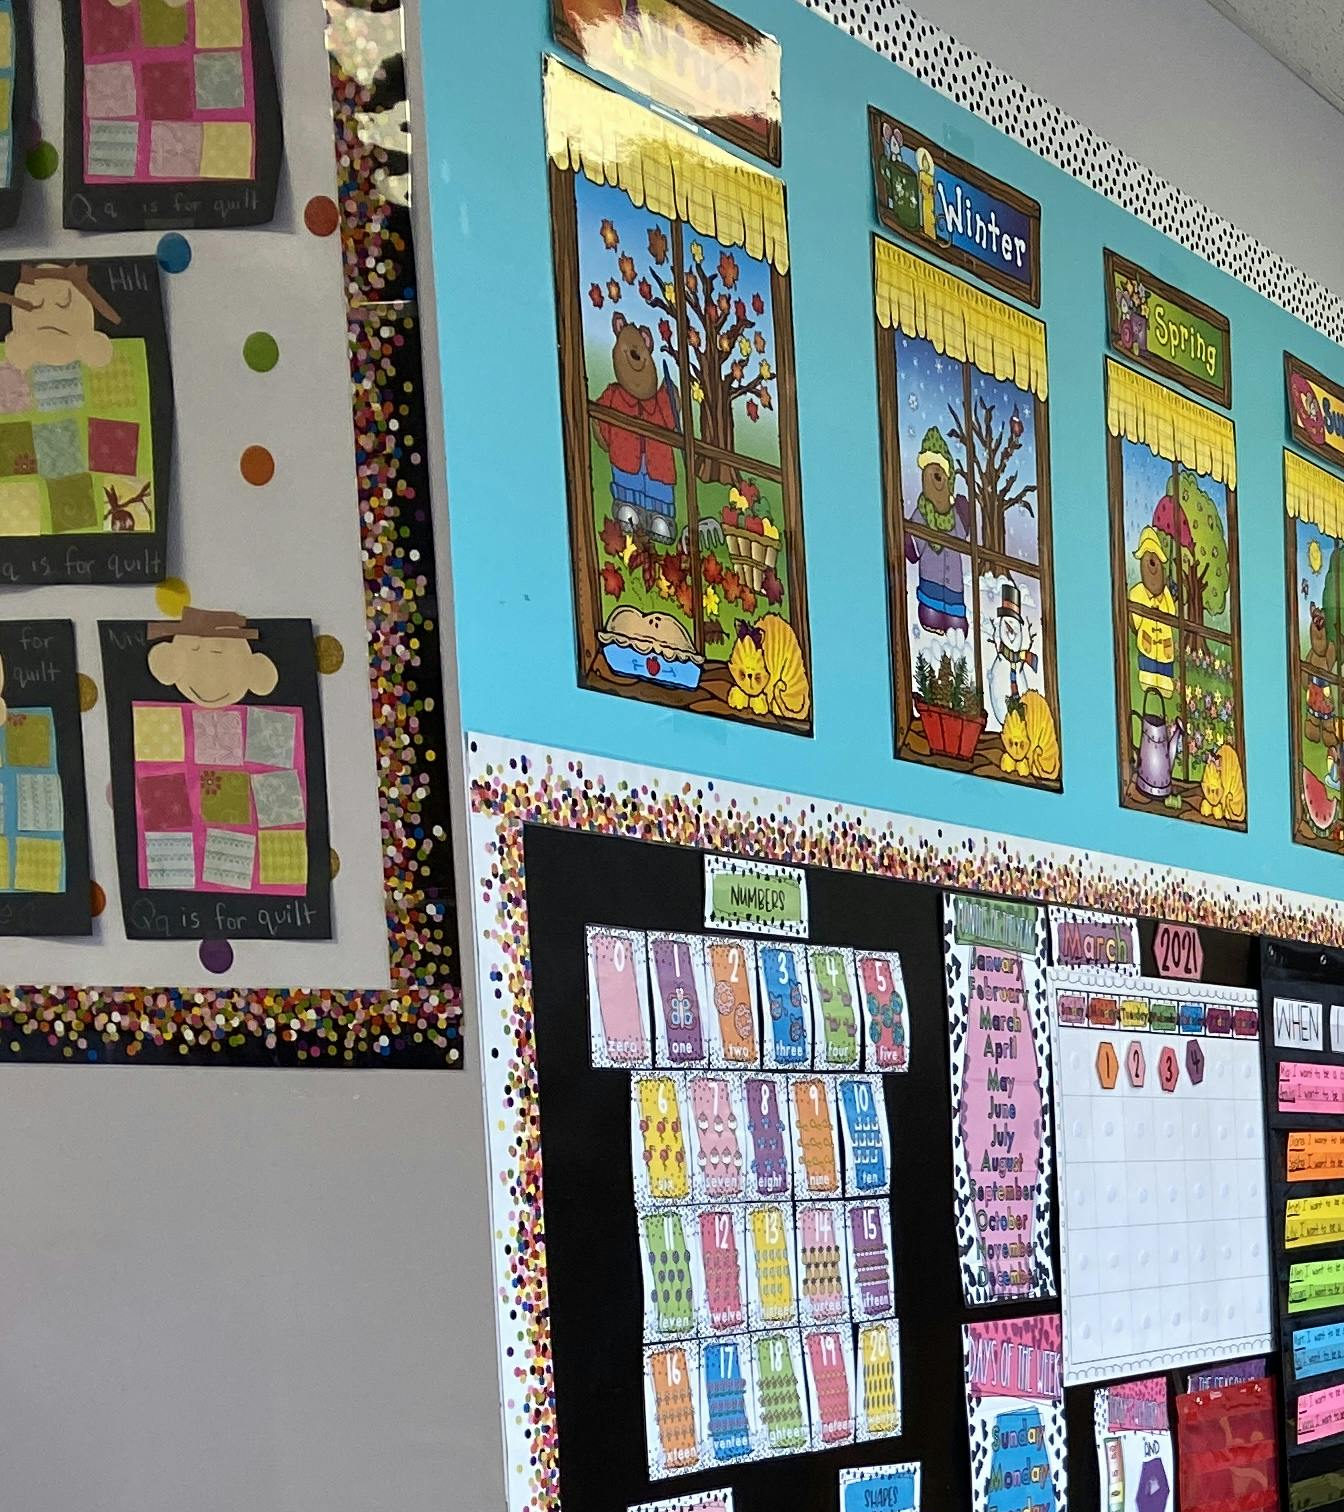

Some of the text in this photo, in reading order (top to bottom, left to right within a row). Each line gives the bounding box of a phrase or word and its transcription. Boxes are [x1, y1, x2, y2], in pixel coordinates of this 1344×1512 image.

[936, 182, 1028, 269] Winter
[1153, 305, 1217, 376] Spring
[731, 885, 785, 912] NUMBERS
[181, 901, 317, 934] is for quilt
[614, 942, 625, 972] 0
[1063, 923, 1129, 962] March
[1161, 928, 1198, 974] 2021
[674, 944, 680, 978] 1
[728, 949, 740, 983] 2
[778, 952, 789, 984] 3
[826, 954, 839, 986] 4
[875, 962, 887, 991] 5
[970, 946, 1023, 981] January
[968, 976, 1030, 1011] February
[979, 1006, 1022, 1033] March
[1276, 1001, 1319, 1041] WHEN
[1337, 1009, 1340, 1044] I
[672, 1042, 692, 1054] one
[729, 1044, 748, 1057] two
[776, 1045, 802, 1057] three
[828, 1046, 849, 1057] four
[880, 1048, 897, 1061] five
[984, 1034, 1017, 1064] April
[987, 1067, 1015, 1098] May
[658, 1084, 668, 1114] 6
[708, 1082, 718, 1115] 7
[760, 1084, 770, 1115] 8
[809, 1085, 818, 1116] 9
[853, 1084, 869, 1113] 10
[988, 1096, 1016, 1119] June
[991, 1123, 1015, 1153] July
[862, 1173, 878, 1184] ten
[981, 1150, 1023, 1178] August
[705, 1177, 737, 1187] seven
[758, 1176, 783, 1189] eight
[970, 1177, 1035, 1208] September
[714, 1215, 729, 1250] 12
[863, 1209, 878, 1239] 15
[976, 1207, 1028, 1233] October
[976, 1234, 1037, 1261] November
[719, 1346, 734, 1378] 17
[768, 1341, 782, 1372] 18
[820, 1334, 837, 1366] 19
[666, 1353, 680, 1387] 16
[968, 1336, 1062, 1398] DAYS OF THE WEEK
[992, 1418, 1045, 1452] Sunday
[988, 1457, 1050, 1493] Monday
[864, 1486, 899, 1508] SHAPES
